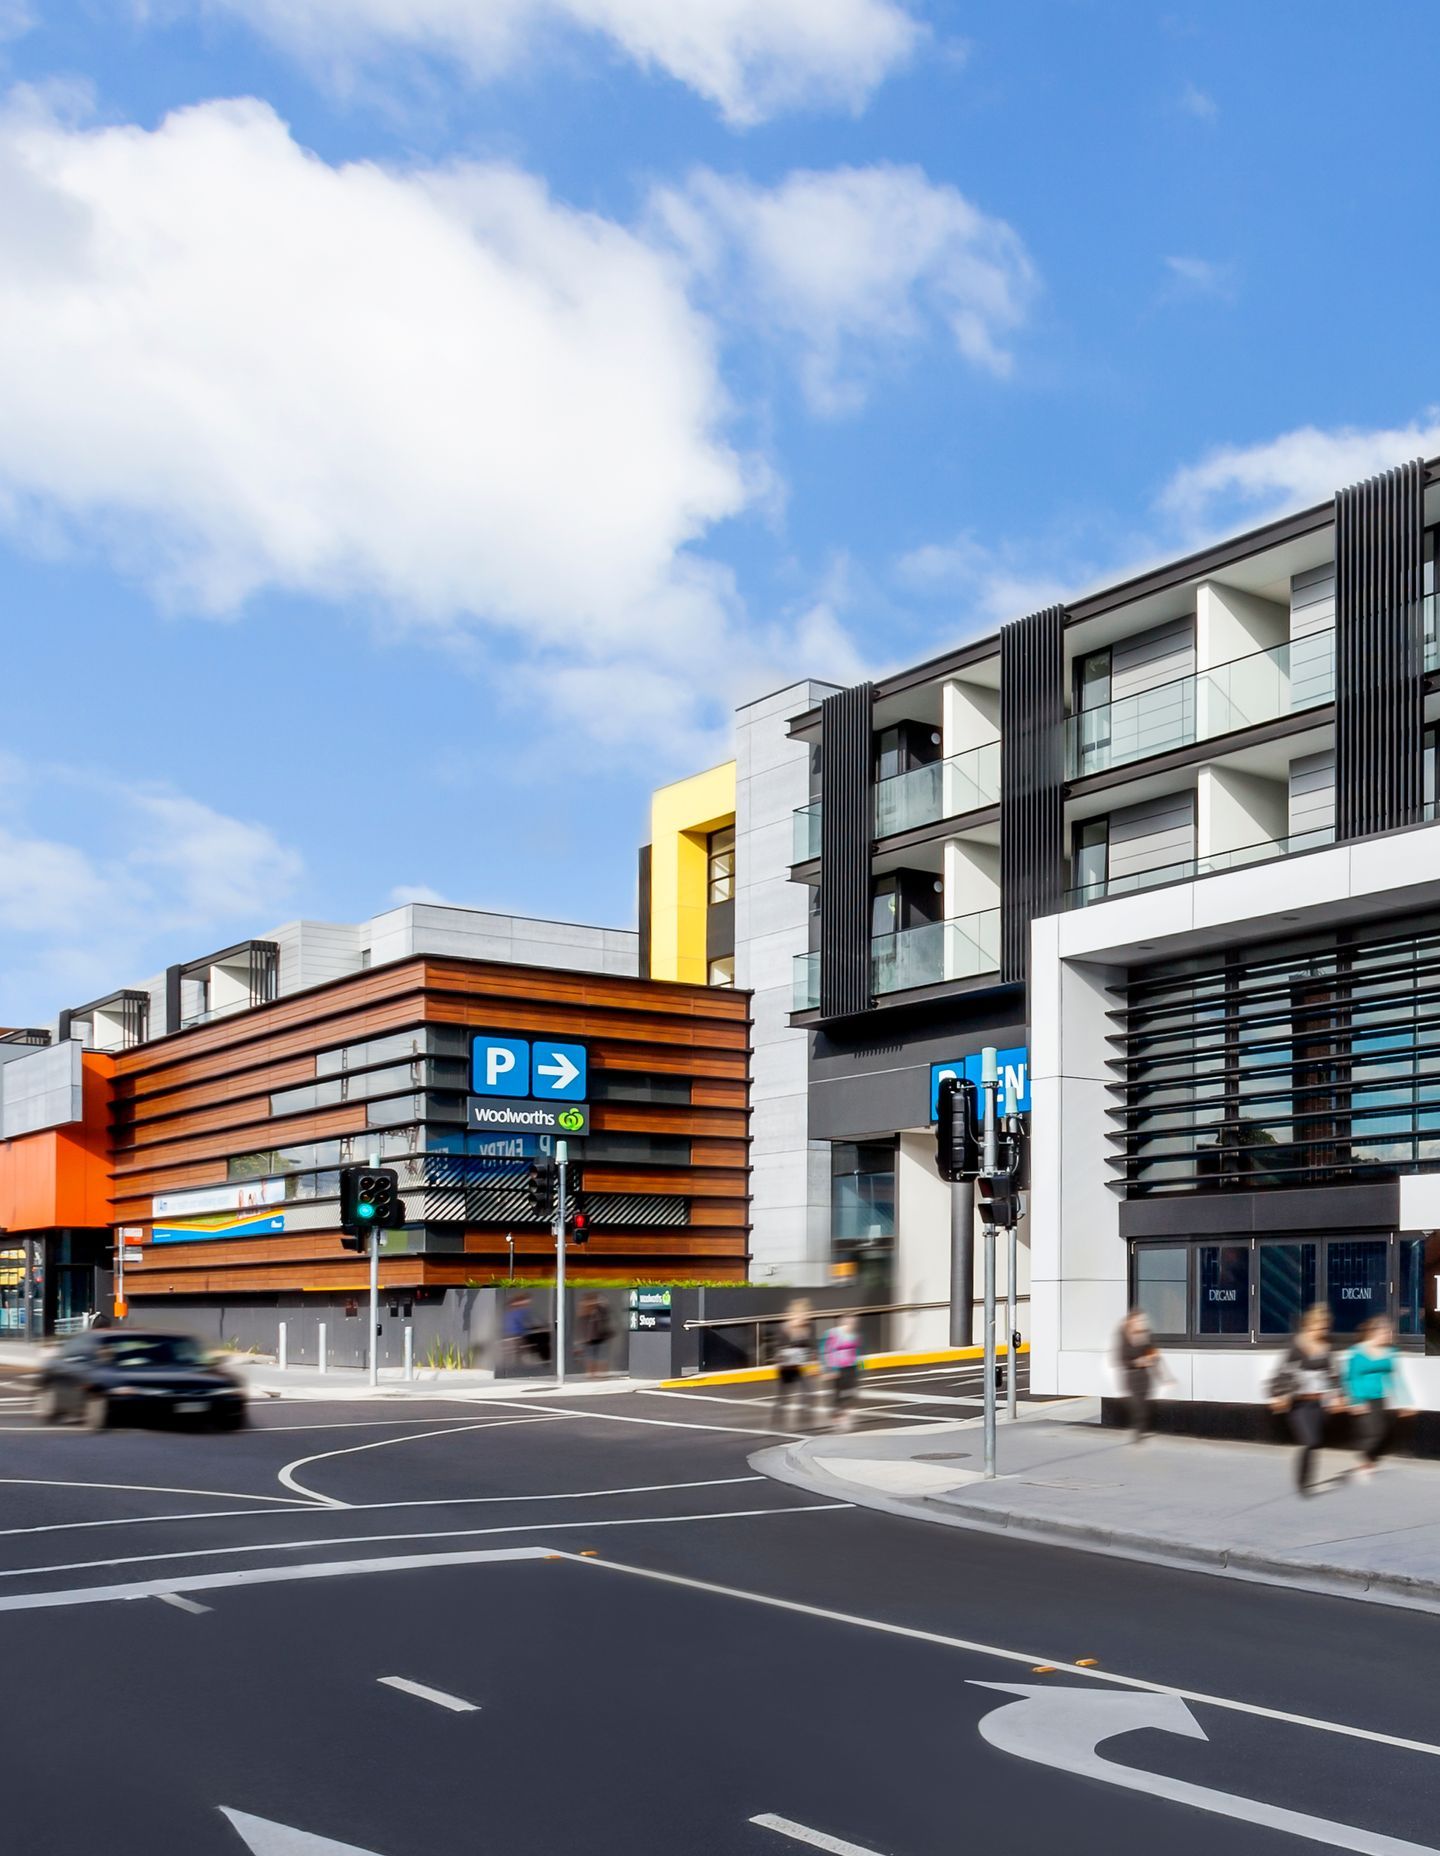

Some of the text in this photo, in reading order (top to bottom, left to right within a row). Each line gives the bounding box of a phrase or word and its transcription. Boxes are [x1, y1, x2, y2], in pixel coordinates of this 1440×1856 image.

[487, 1047, 515, 1086] P
[475, 1108, 555, 1126] Woolworths
[1209, 1289, 1237, 1301] DEGANI
[1342, 1287, 1372, 1300] DEGANI
